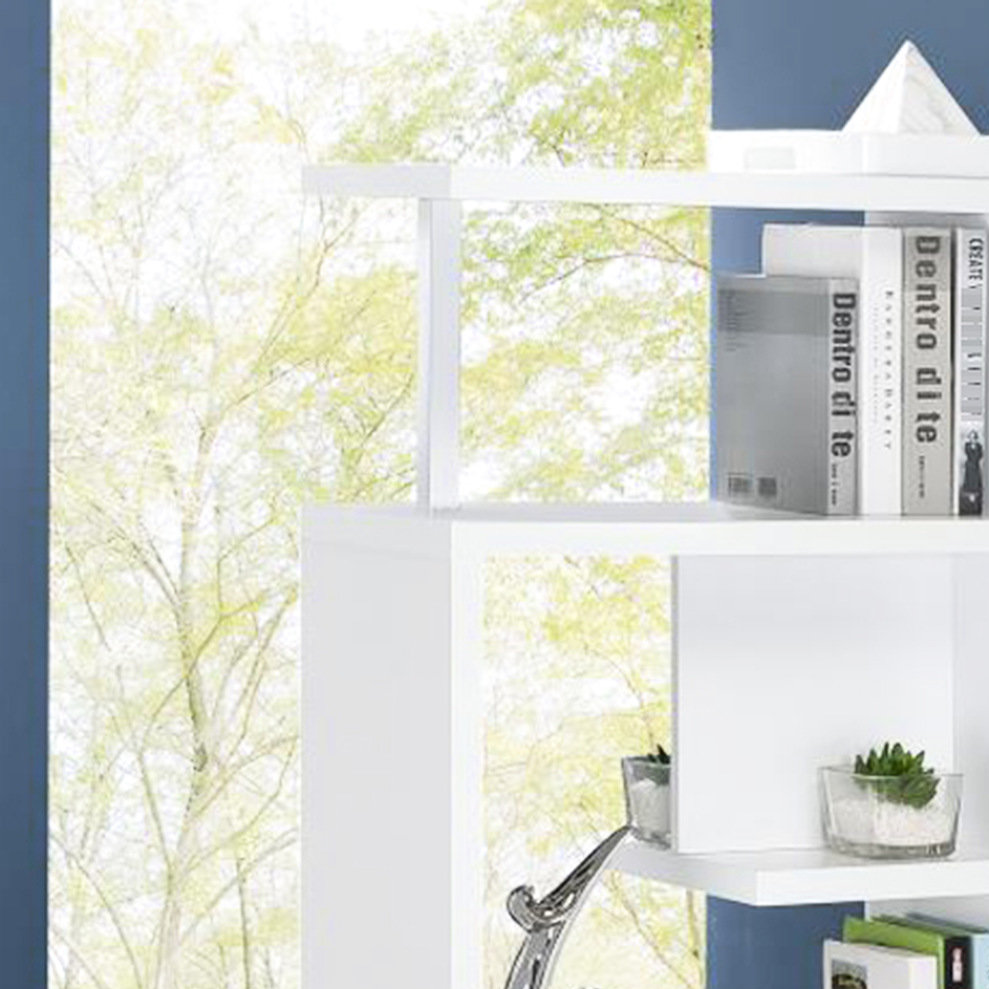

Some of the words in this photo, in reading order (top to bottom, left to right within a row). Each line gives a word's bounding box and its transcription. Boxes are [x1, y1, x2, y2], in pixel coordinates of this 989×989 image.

[968, 238, 984, 280] CREATE
[915, 236, 940, 350] Dentro
[832, 293, 856, 383] Dentro
[916, 368, 942, 400] di
[832, 391, 856, 416] di
[915, 411, 941, 443] te
[832, 431, 853, 457] te
